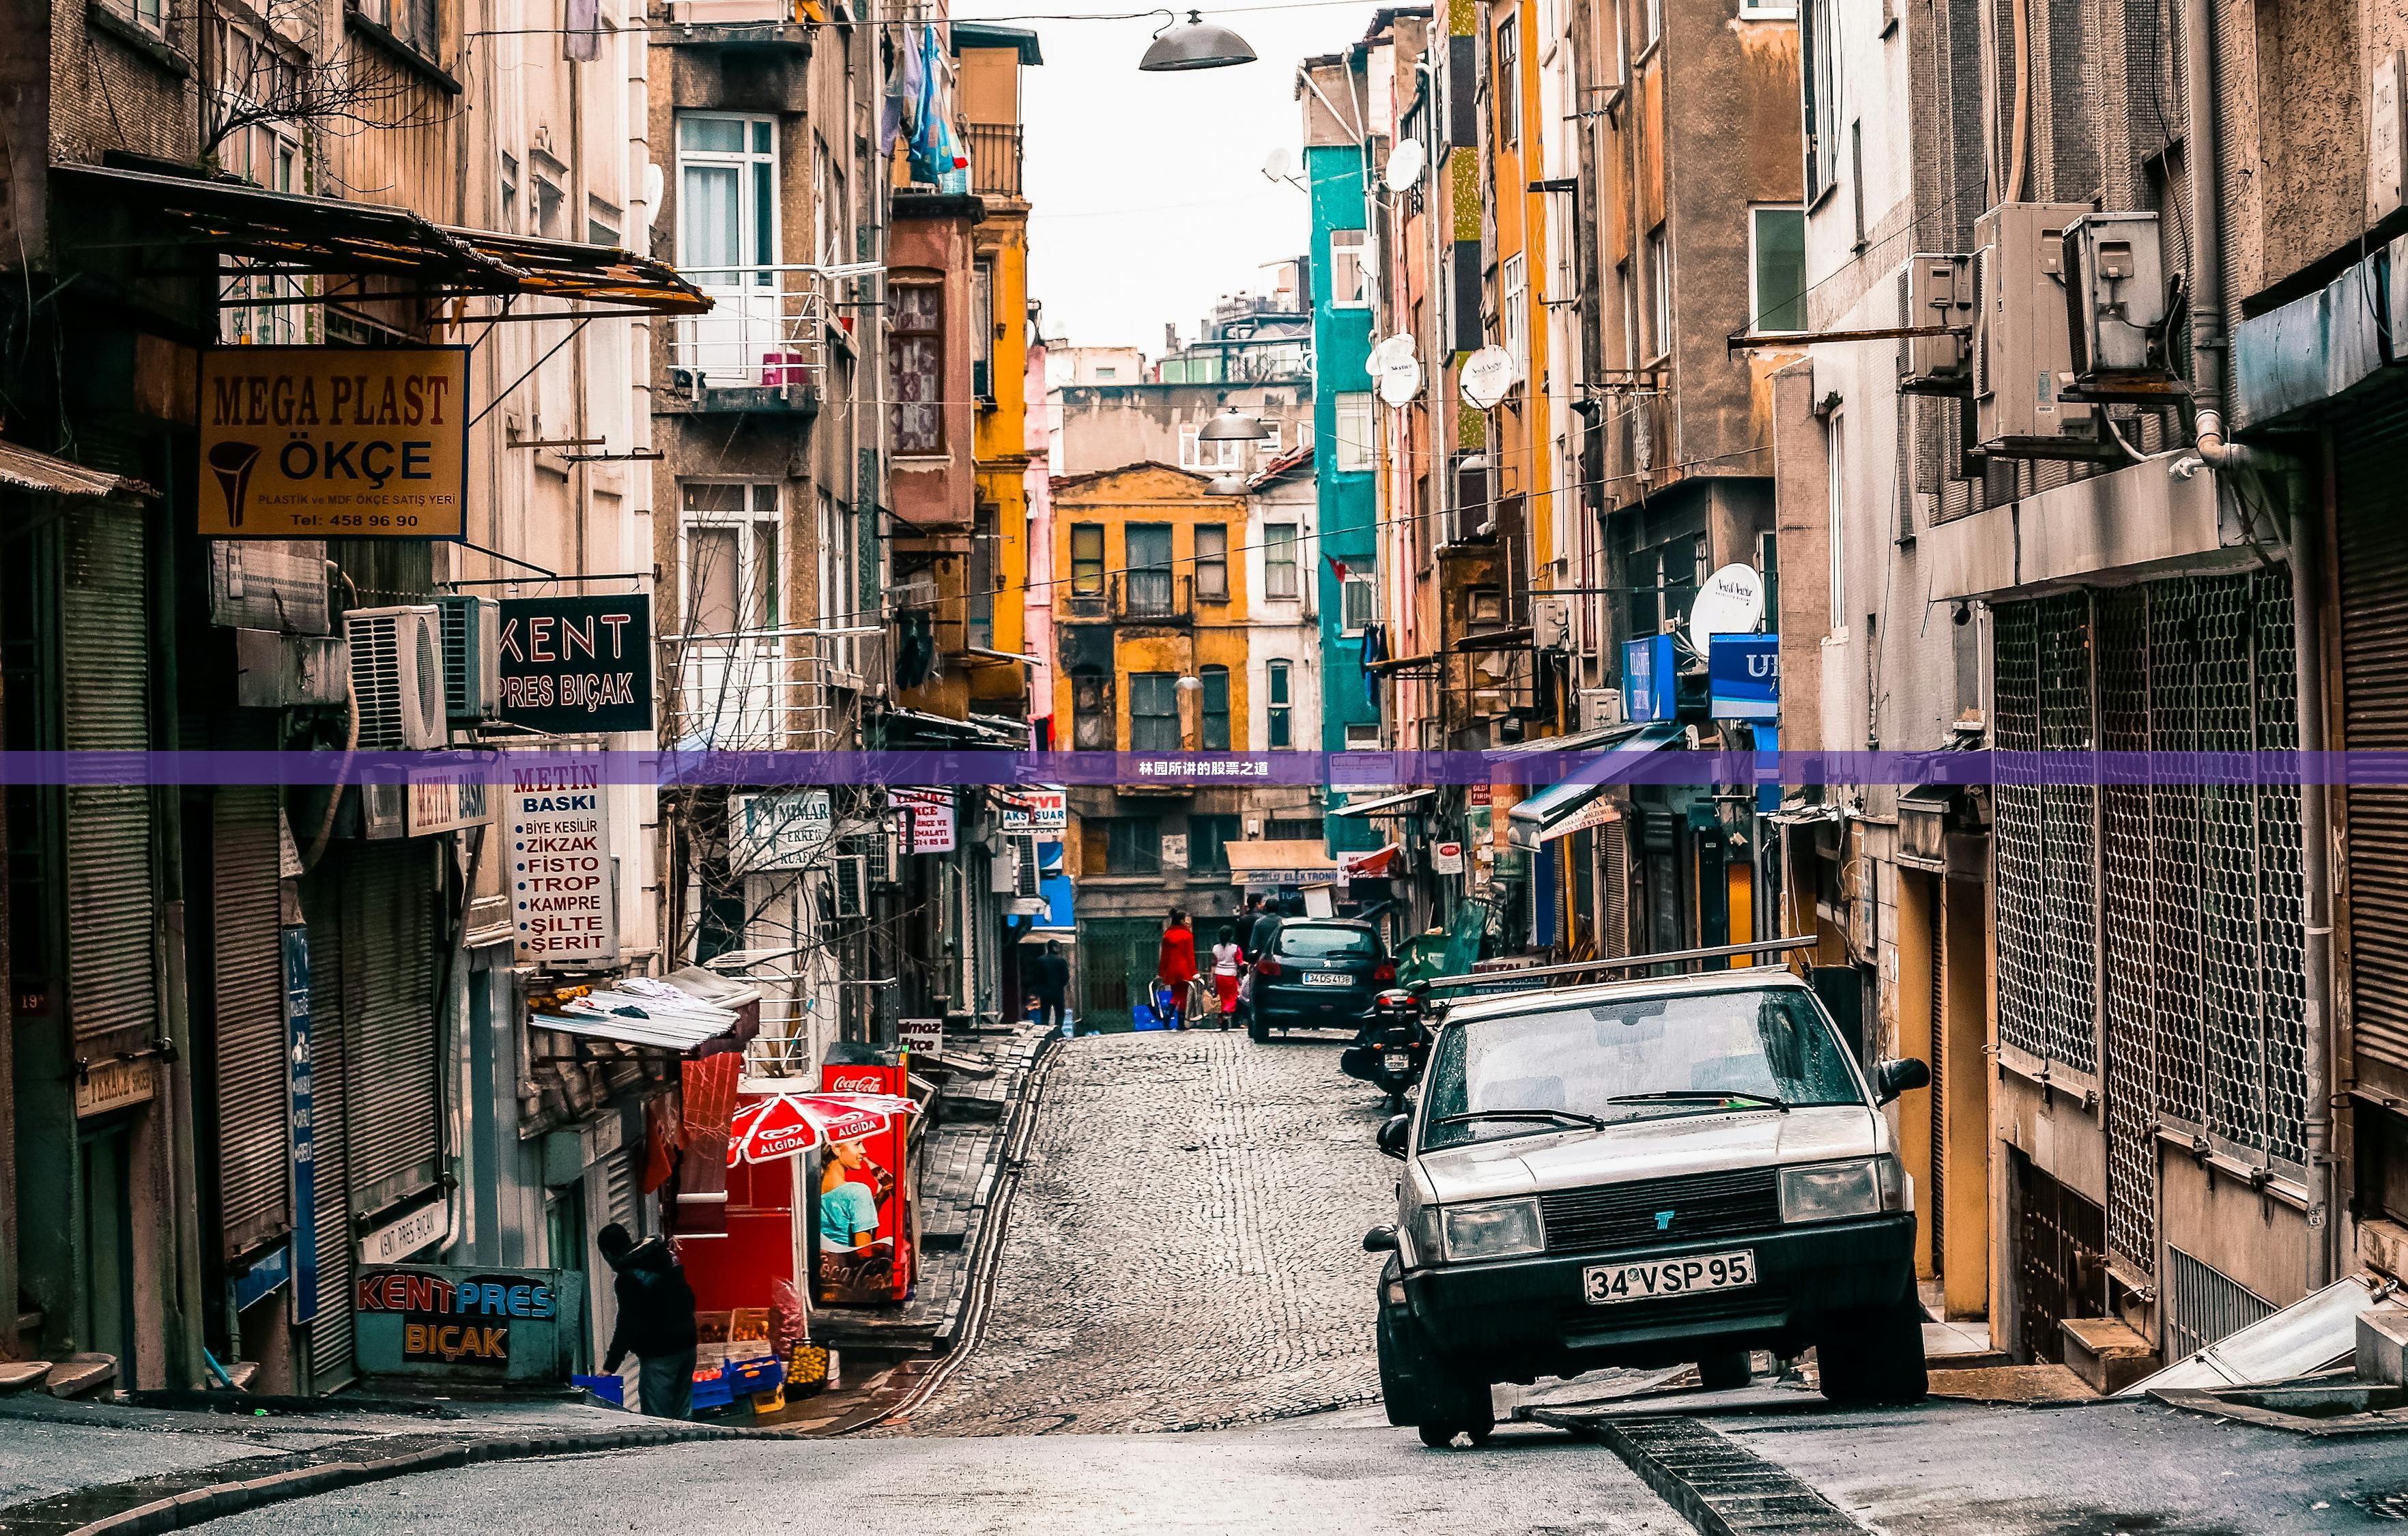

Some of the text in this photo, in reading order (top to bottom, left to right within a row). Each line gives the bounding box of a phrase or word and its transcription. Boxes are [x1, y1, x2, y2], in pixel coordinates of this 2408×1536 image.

[213, 374, 448, 427] MEGA PLAST
[280, 432, 432, 489] ÖKÇE
[258, 493, 456, 507] PLASTİK ve MDF ÖKÇE SATIŞ YERİ
[290, 514, 418, 526] Tel: 458 96 90
[500, 614, 631, 662] KENT
[560, 672, 634, 712] BIÇAK
[513, 759, 598, 793] METİN
[459, 771, 487, 819] BASKI
[524, 795, 596, 813] BASKI
[526, 817, 598, 834] BİYE KESİLİR
[1005, 810, 1064, 821] AKSSUAR
[527, 836, 598, 853] ZİKZAK
[528, 855, 599, 873] FİSTO
[529, 876, 601, 892] TROP
[530, 896, 601, 912] KAMPRE
[530, 915, 603, 936] ŞİLTE
[531, 933, 605, 954] ŞERİT
[1590, 1256, 1748, 1300] 34 VSP 95
[405, 1324, 508, 1361] BIÇAK
